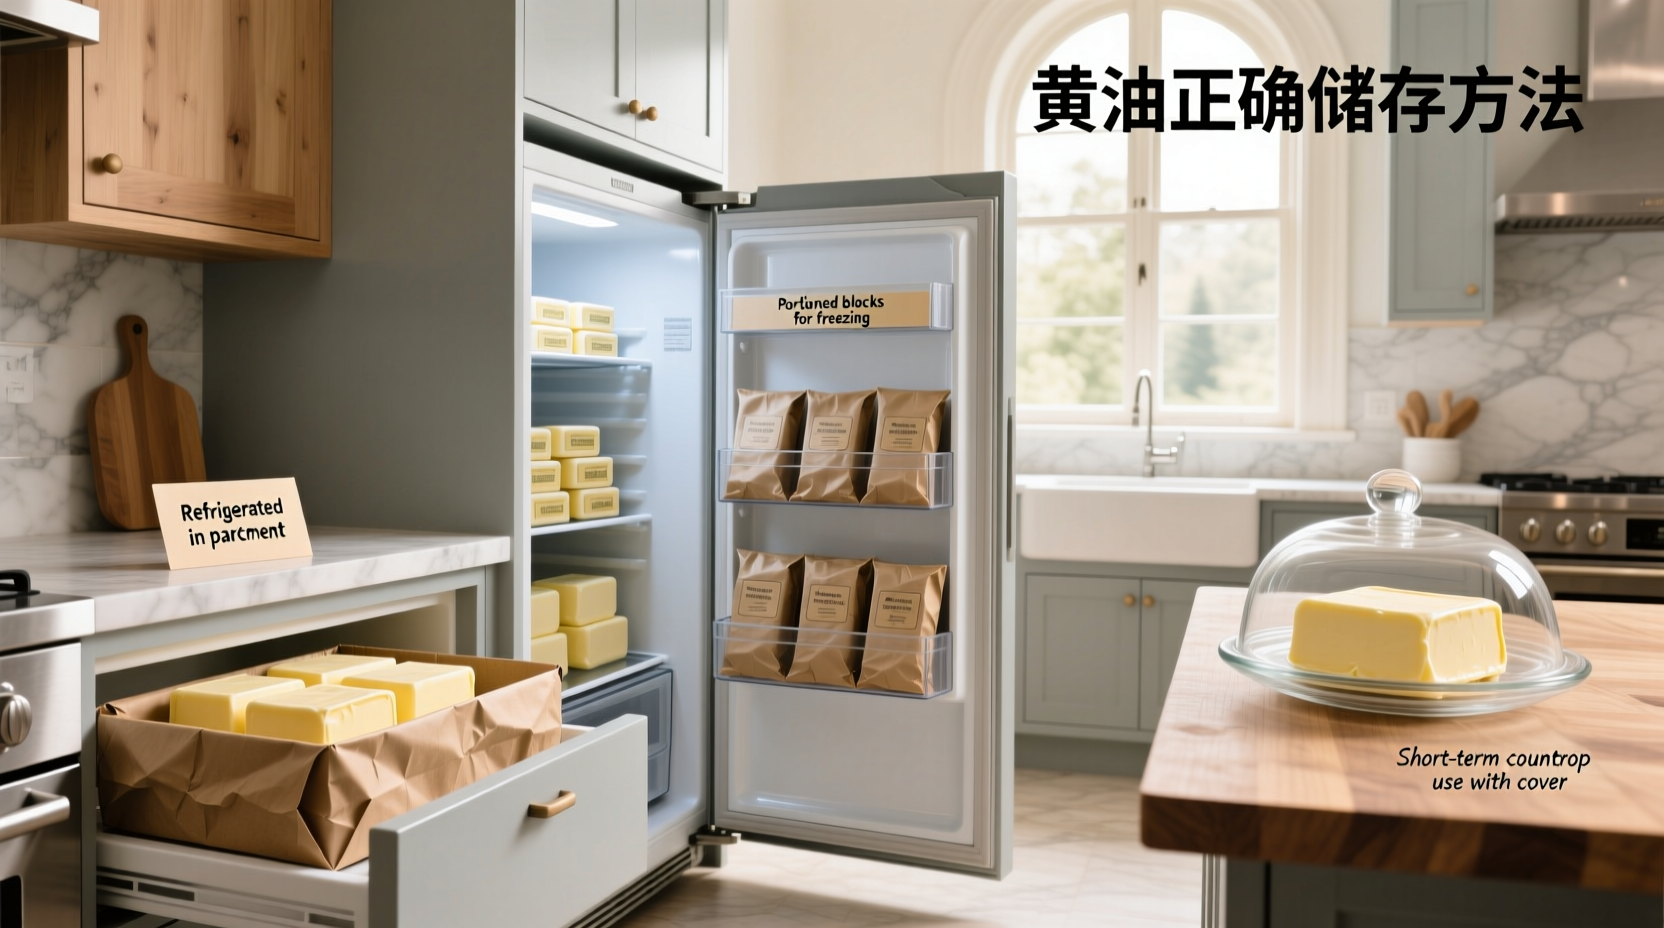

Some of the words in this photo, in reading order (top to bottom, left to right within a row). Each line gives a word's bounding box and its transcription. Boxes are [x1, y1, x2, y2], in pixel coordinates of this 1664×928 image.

[843, 295, 884, 308] blocks
[794, 312, 813, 325] for
[816, 311, 870, 328] freezing
[181, 497, 283, 523] Refrigerated
[188, 528, 205, 546] in
